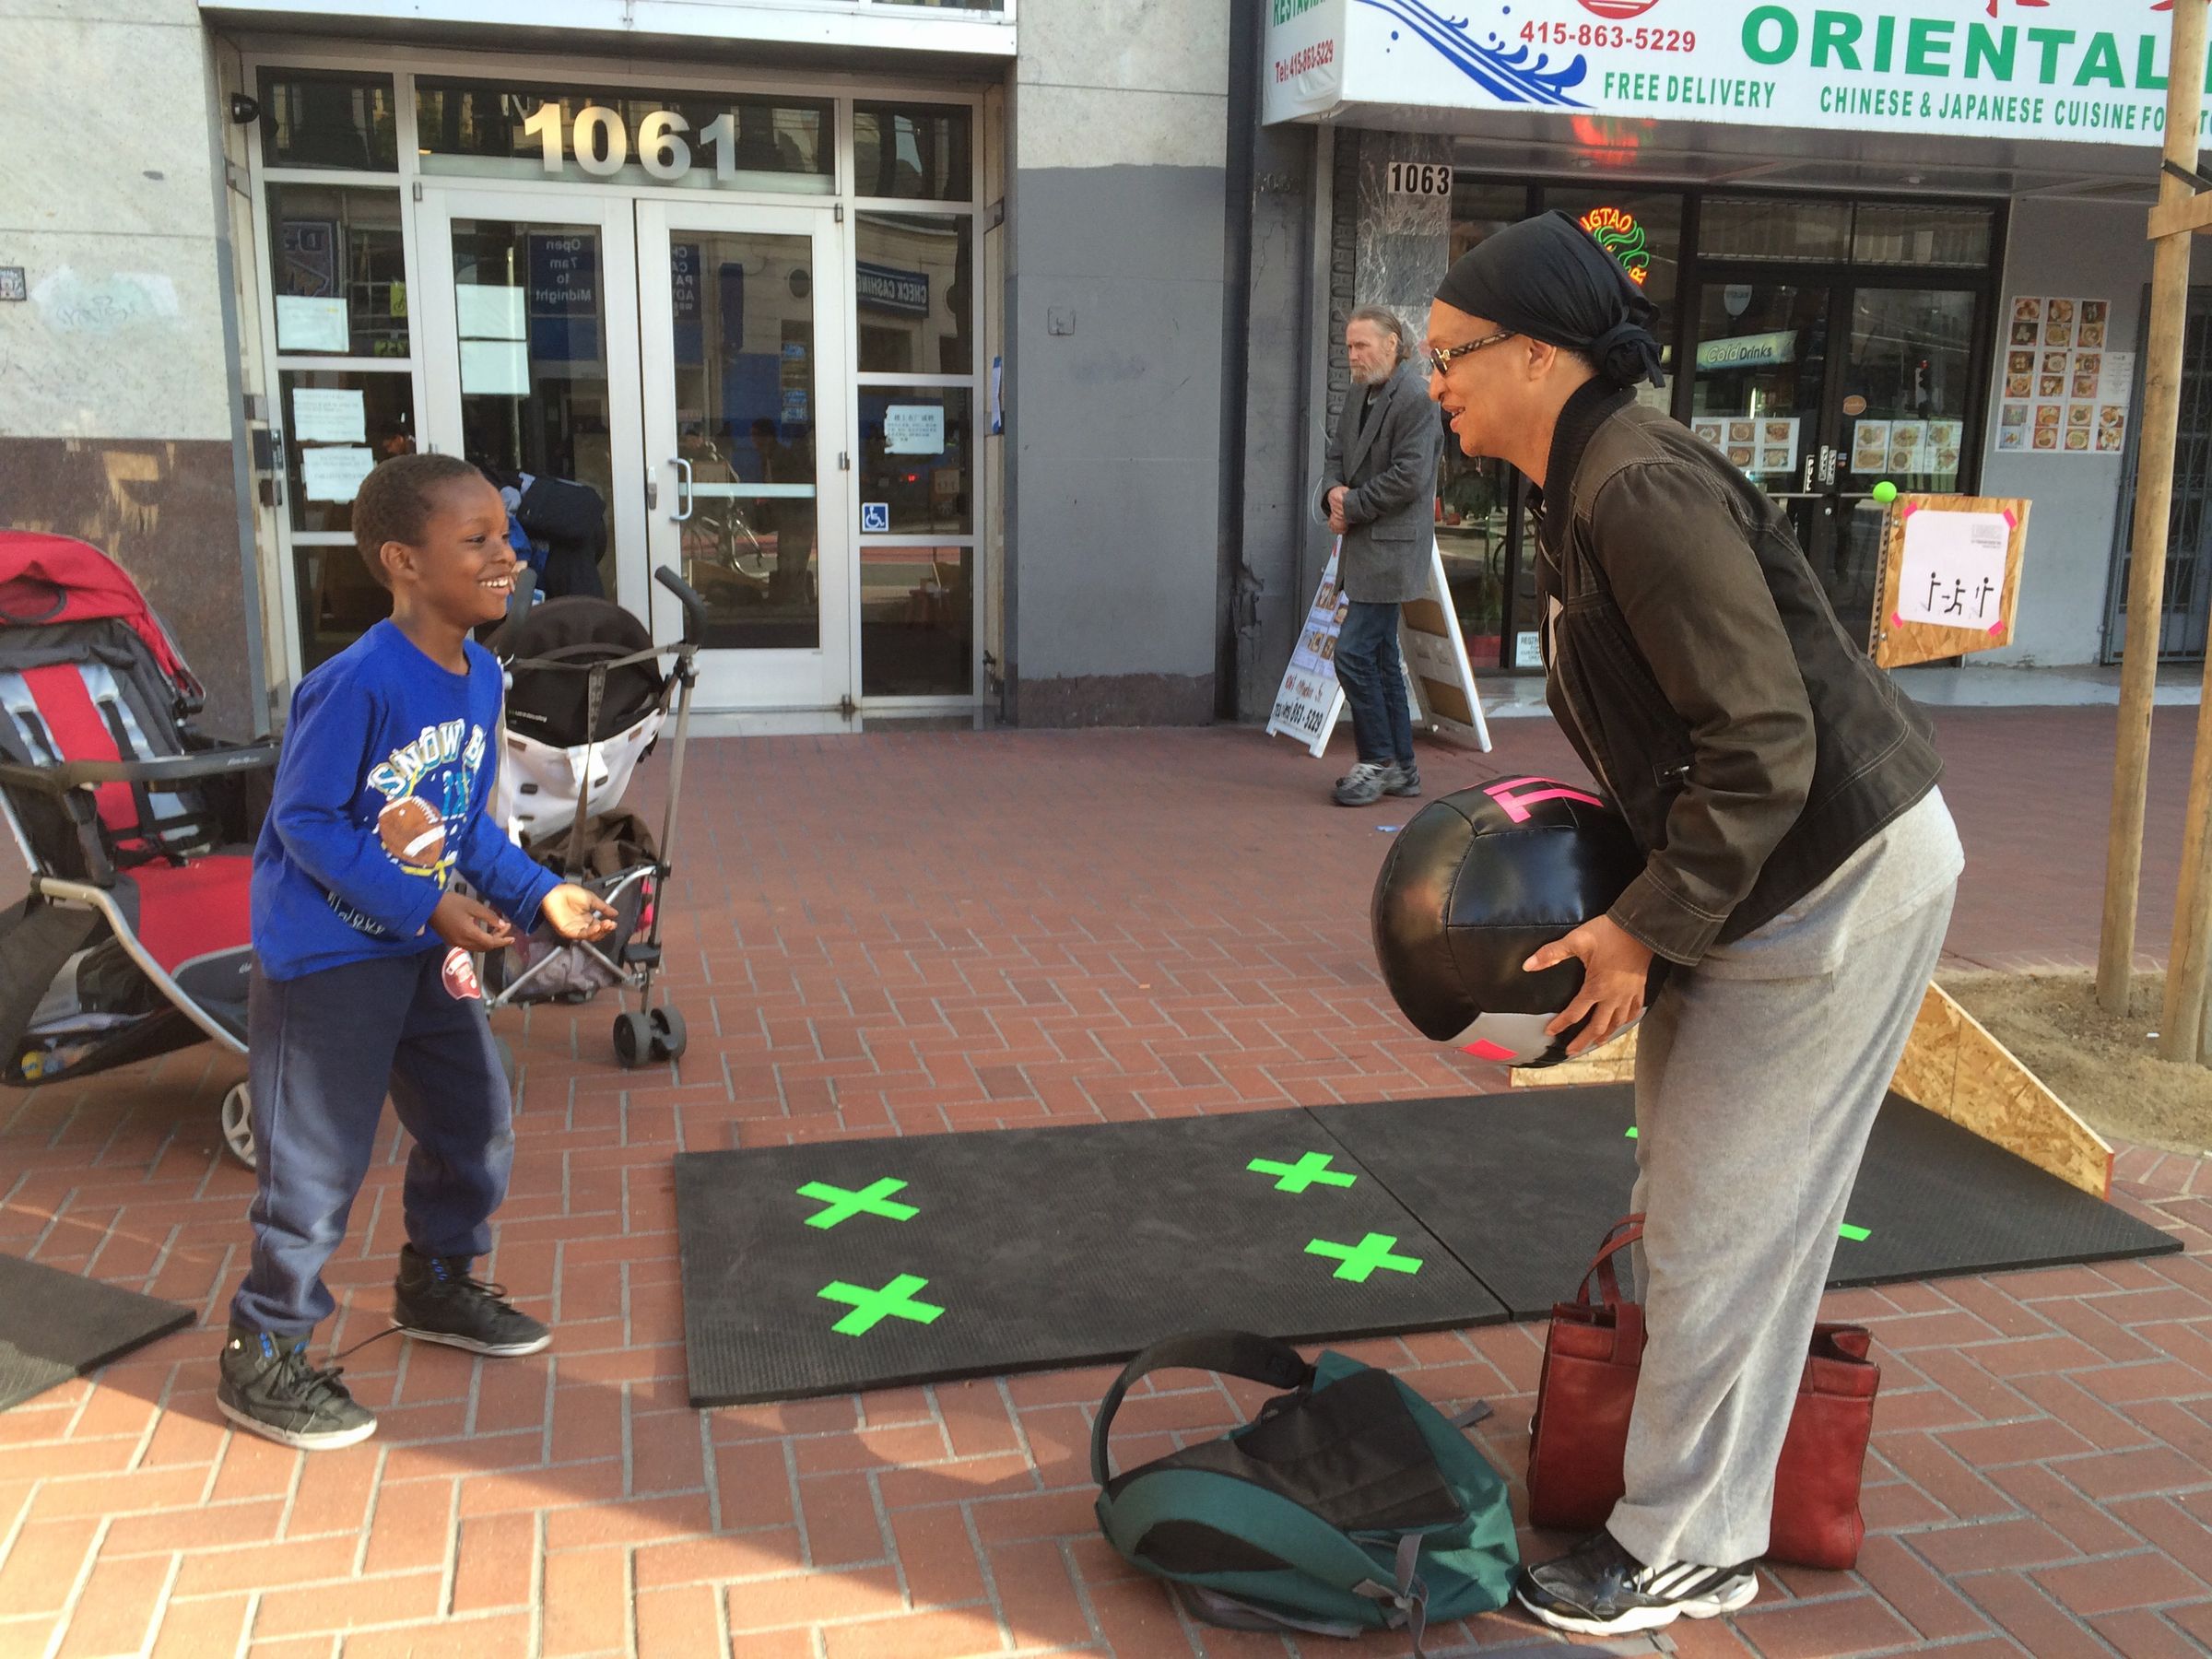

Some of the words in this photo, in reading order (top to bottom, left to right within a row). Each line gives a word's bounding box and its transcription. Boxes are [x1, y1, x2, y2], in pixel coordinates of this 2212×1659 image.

[1520, 20, 1697, 53] 415-863-5229
[1741, 5, 2170, 90] ORIENTAL
[1275, 58, 1289, 84] Tel:
[1290, 39, 1334, 77] 415-863-5229
[1604, 72, 1660, 101] FREE
[1666, 75, 1776, 109] DELIVERY
[1819, 86, 1913, 117] CHINESE
[1919, 92, 1932, 118] &
[1938, 92, 2044, 125] JAPANESE
[2054, 100, 2137, 131] CUISINE
[2141, 105, 2165, 133] FO
[524, 102, 735, 182] 1061
[1392, 164, 1450, 195] 1063
[368, 718, 465, 801] SNOW
